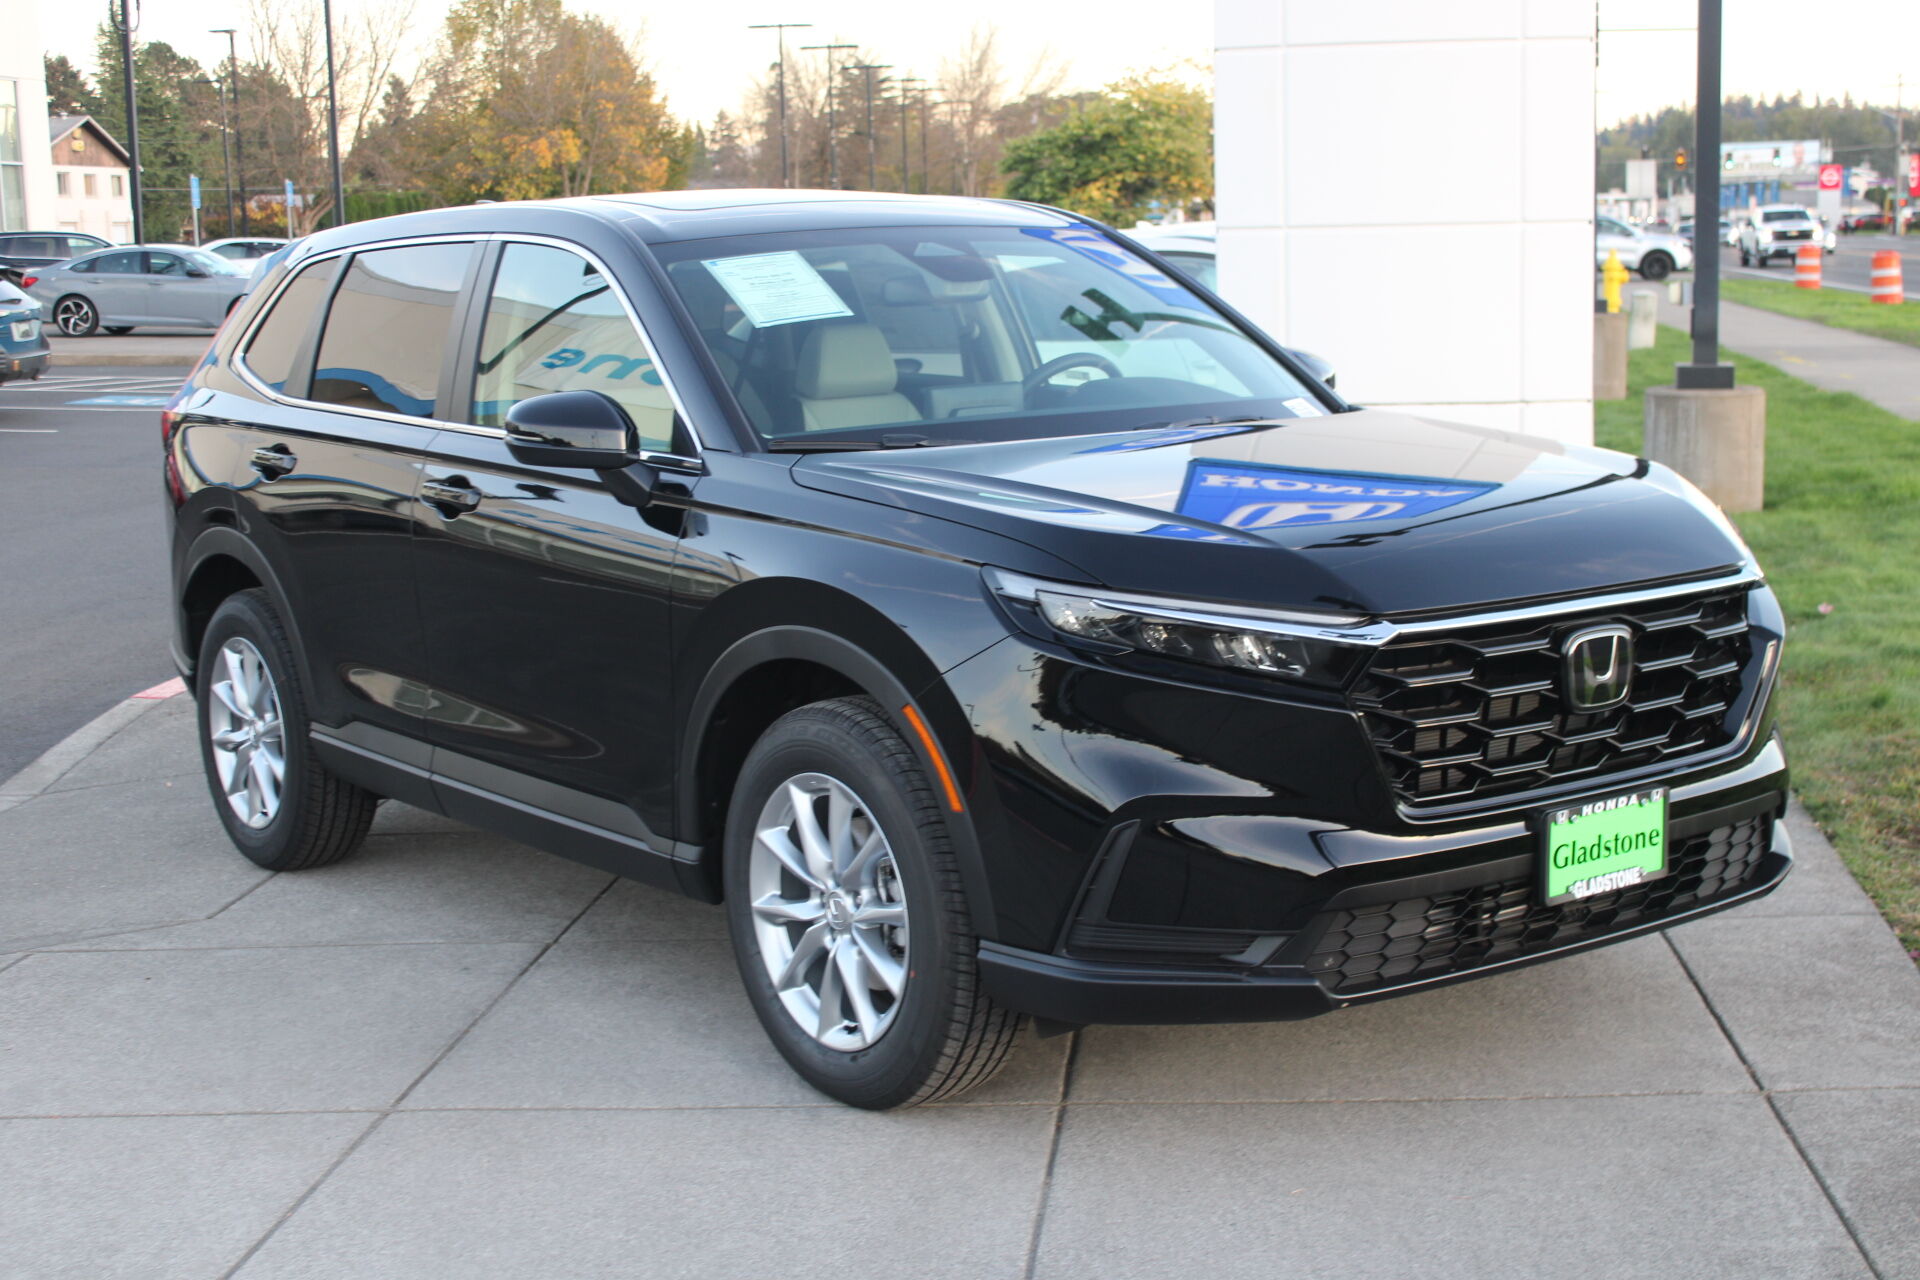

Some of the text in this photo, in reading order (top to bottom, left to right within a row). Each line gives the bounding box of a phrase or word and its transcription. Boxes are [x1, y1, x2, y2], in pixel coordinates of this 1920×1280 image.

[1581, 794, 1638, 816] HONDA
[1553, 829, 1660, 869] Gladstone
[1574, 866, 1641, 899] GLADSTONE
